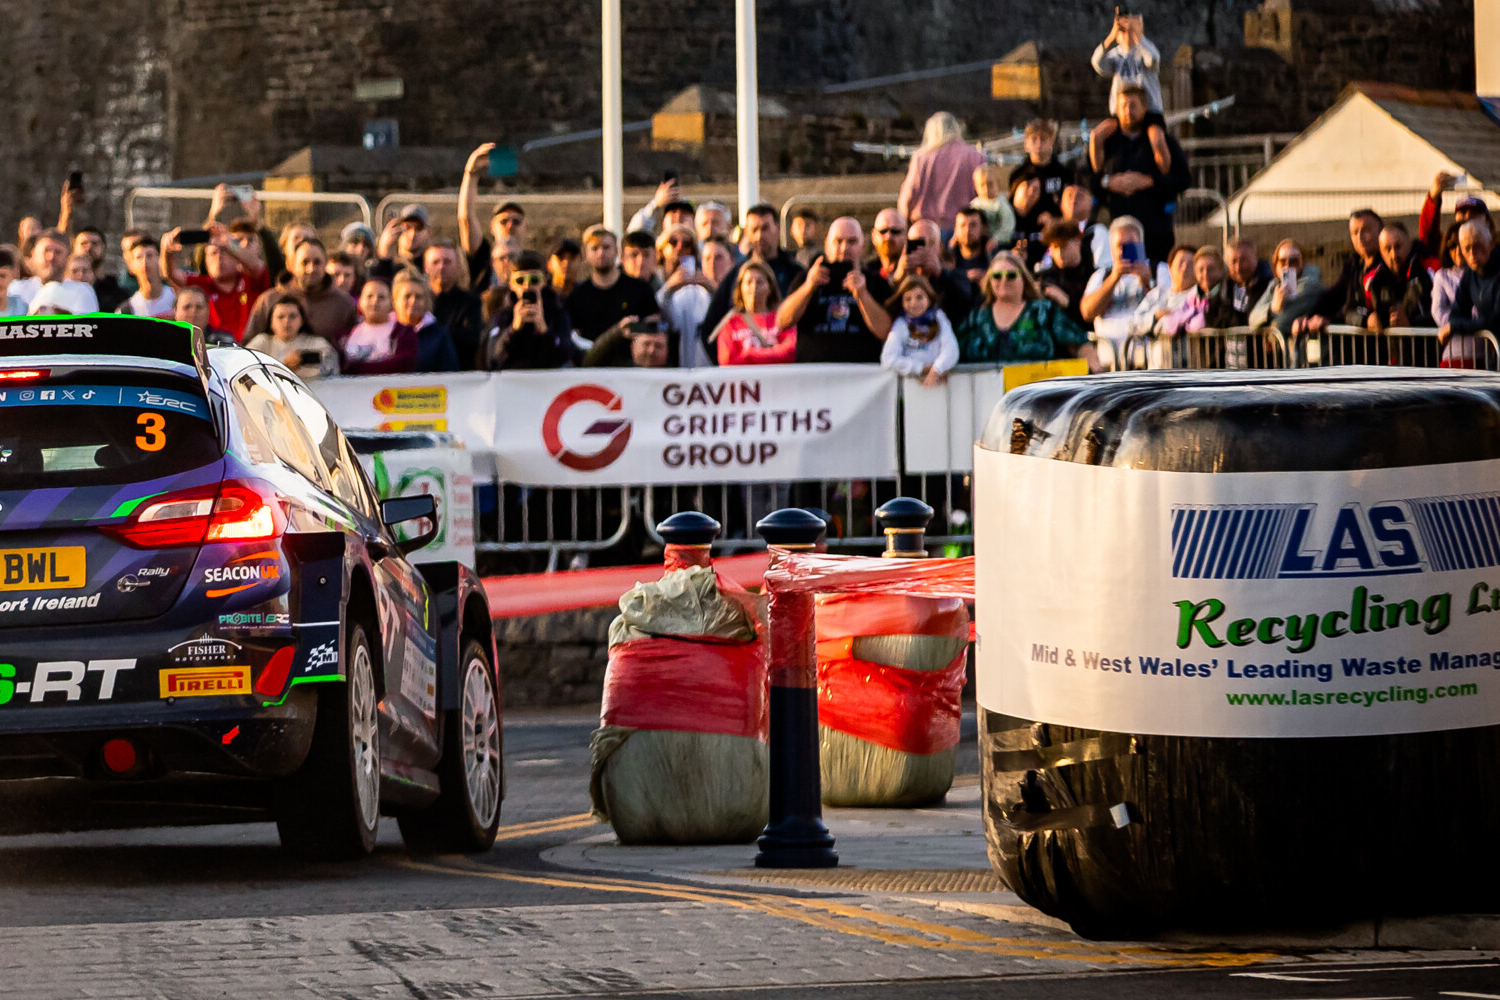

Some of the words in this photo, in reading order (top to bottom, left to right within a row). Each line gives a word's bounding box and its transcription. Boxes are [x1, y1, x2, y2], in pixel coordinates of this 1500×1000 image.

[662, 380, 762, 406] GAVIN
[135, 412, 167, 452] 3
[663, 408, 832, 436] GRIFFITHS
[662, 442, 778, 468] GROUP
[1279, 503, 1424, 572] LAS
[4, 552, 70, 585] BWL
[32, 592, 102, 612] Ireland
[1172, 585, 1452, 654] Recycling
[187, 645, 226, 656] FISHER
[1031, 643, 1059, 664] Mid
[1065, 651, 1077, 667] &
[1083, 650, 1132, 674] West
[1139, 656, 1219, 678] Wales’
[1227, 659, 1333, 682] Leading
[1341, 656, 1422, 677] Waste
[167, 671, 244, 693] PIRELLI
[1226, 683, 1478, 707] www.lasrecycling.com
